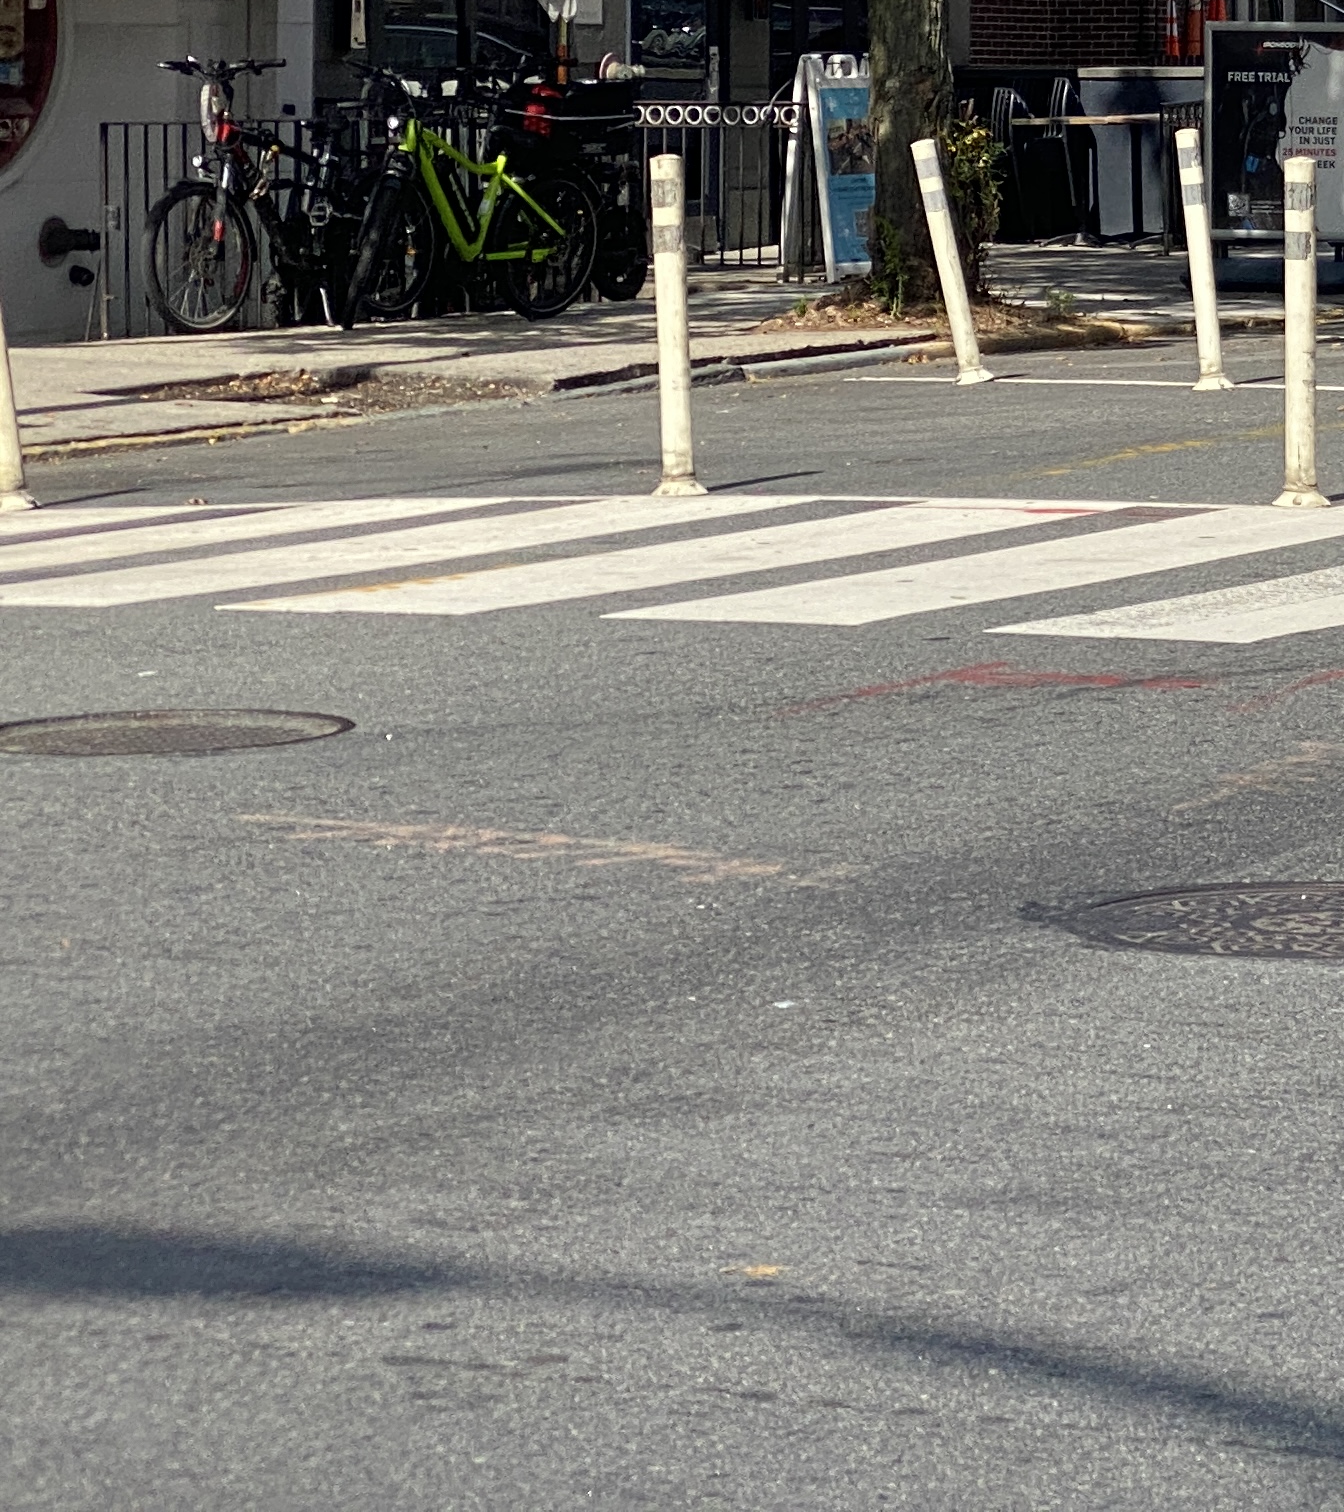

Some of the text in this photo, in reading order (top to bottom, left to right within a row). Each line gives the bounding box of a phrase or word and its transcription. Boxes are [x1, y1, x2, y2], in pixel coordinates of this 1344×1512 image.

[1227, 71, 1290, 83] FREE TRIAL
[1298, 116, 1338, 126] CHANGE
[1289, 126, 1337, 135] YOUR LIFE
[1299, 136, 1335, 145] IN JUST
[1295, 148, 1337, 157] MINUTES
[1316, 160, 1336, 169] EEK
